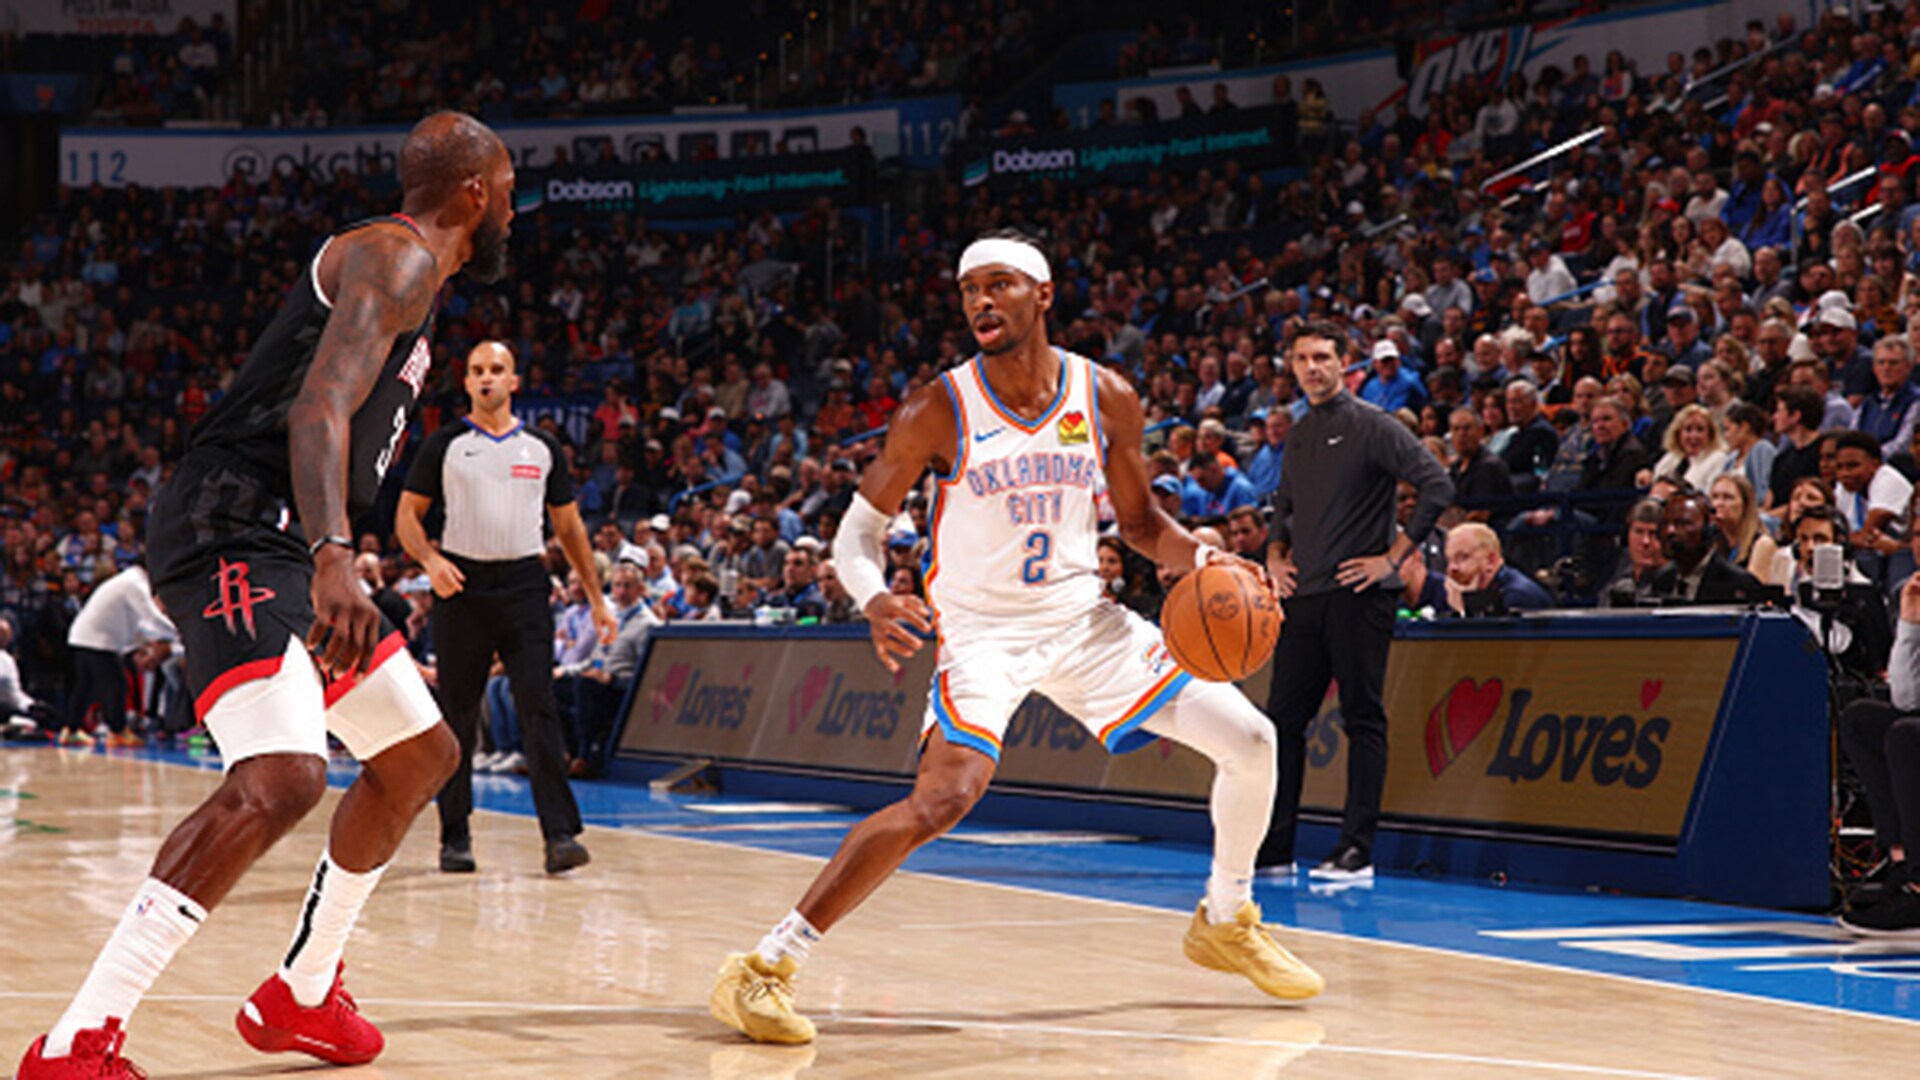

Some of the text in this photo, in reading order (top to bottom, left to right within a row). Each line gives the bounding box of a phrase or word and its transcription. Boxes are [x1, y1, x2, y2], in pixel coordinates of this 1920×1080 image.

[68, 151, 127, 182] 112
[993, 147, 1075, 172] Dobson
[547, 177, 633, 202] Dobson
[966, 452, 1096, 498] OKLAHOMA
[1007, 489, 1063, 526] CITY
[1020, 529, 1053, 587] 2
